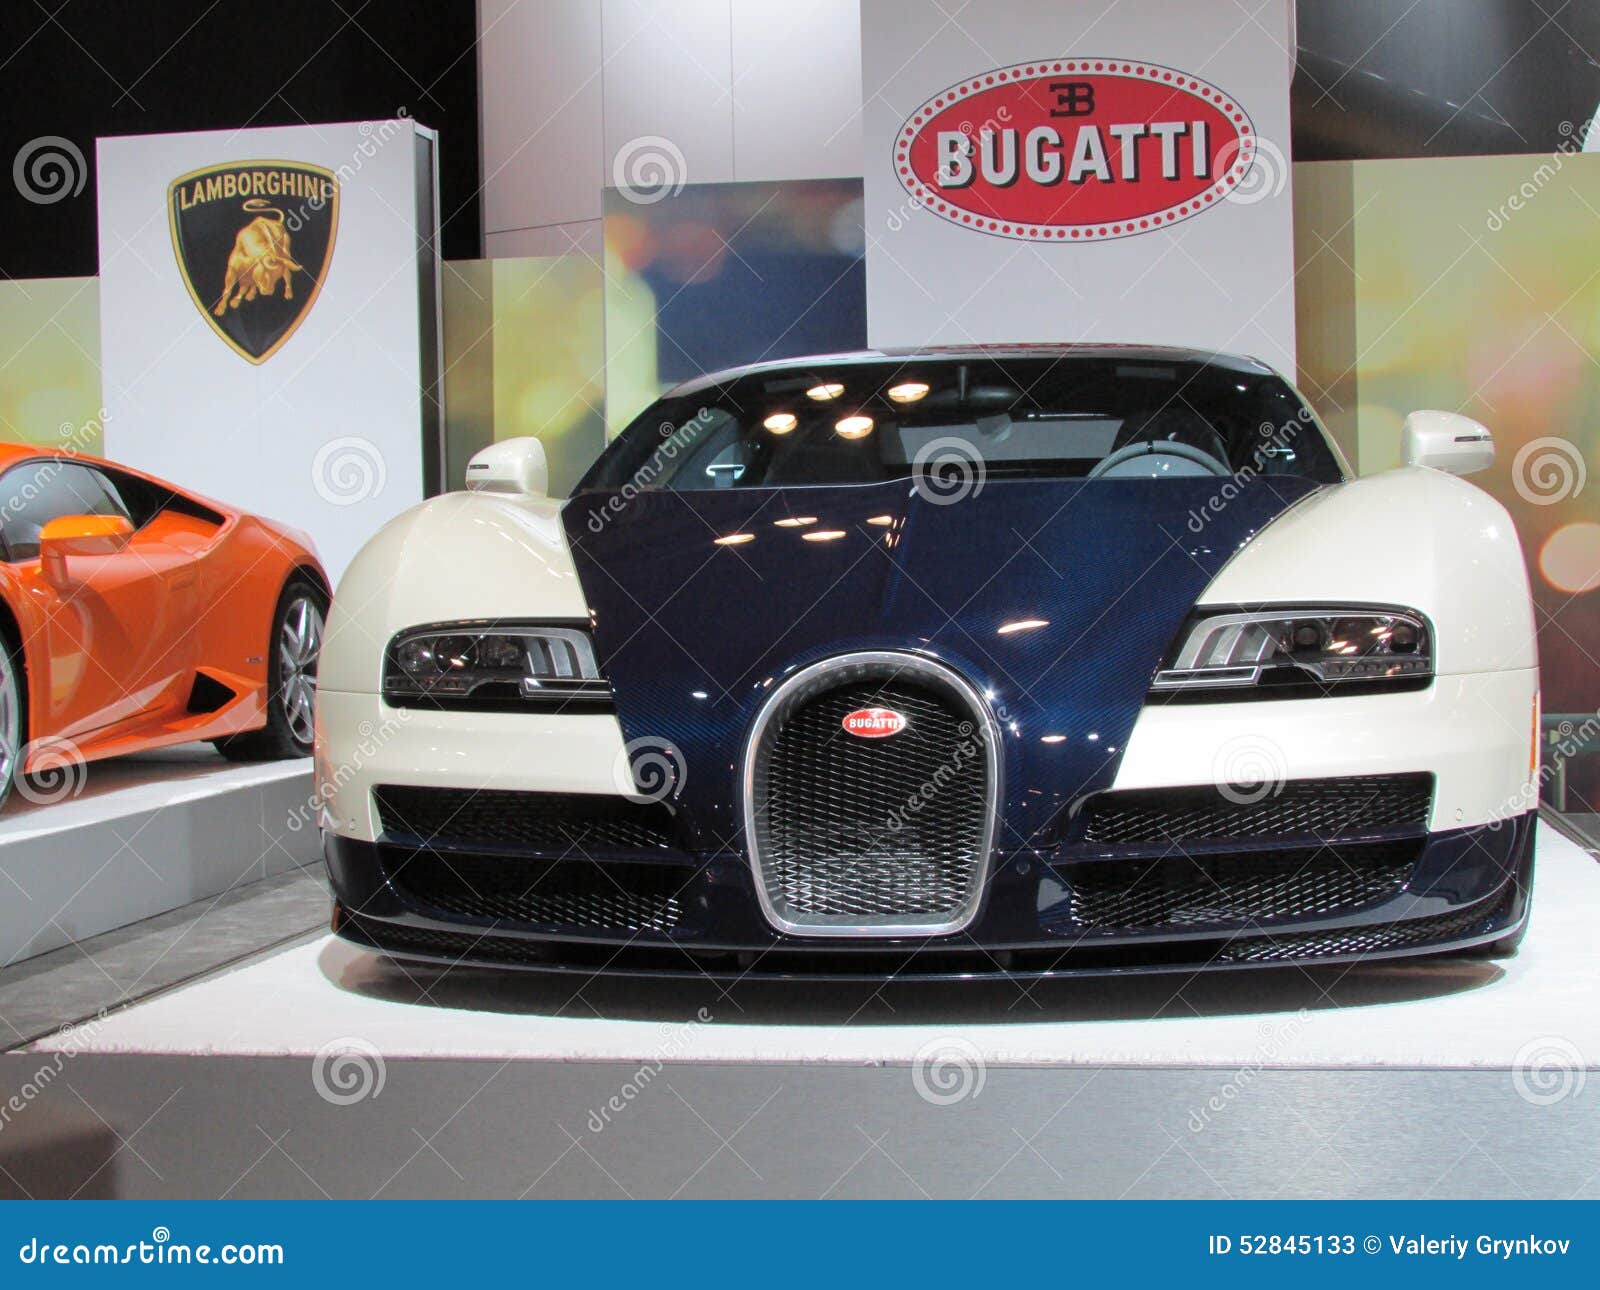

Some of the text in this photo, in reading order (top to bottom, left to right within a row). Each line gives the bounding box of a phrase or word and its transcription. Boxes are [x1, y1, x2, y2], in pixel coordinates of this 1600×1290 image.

[937, 121, 1211, 189] BUGATTI
[180, 171, 328, 211] LAMBORGHINI
[849, 717, 899, 729] BUGATTI
